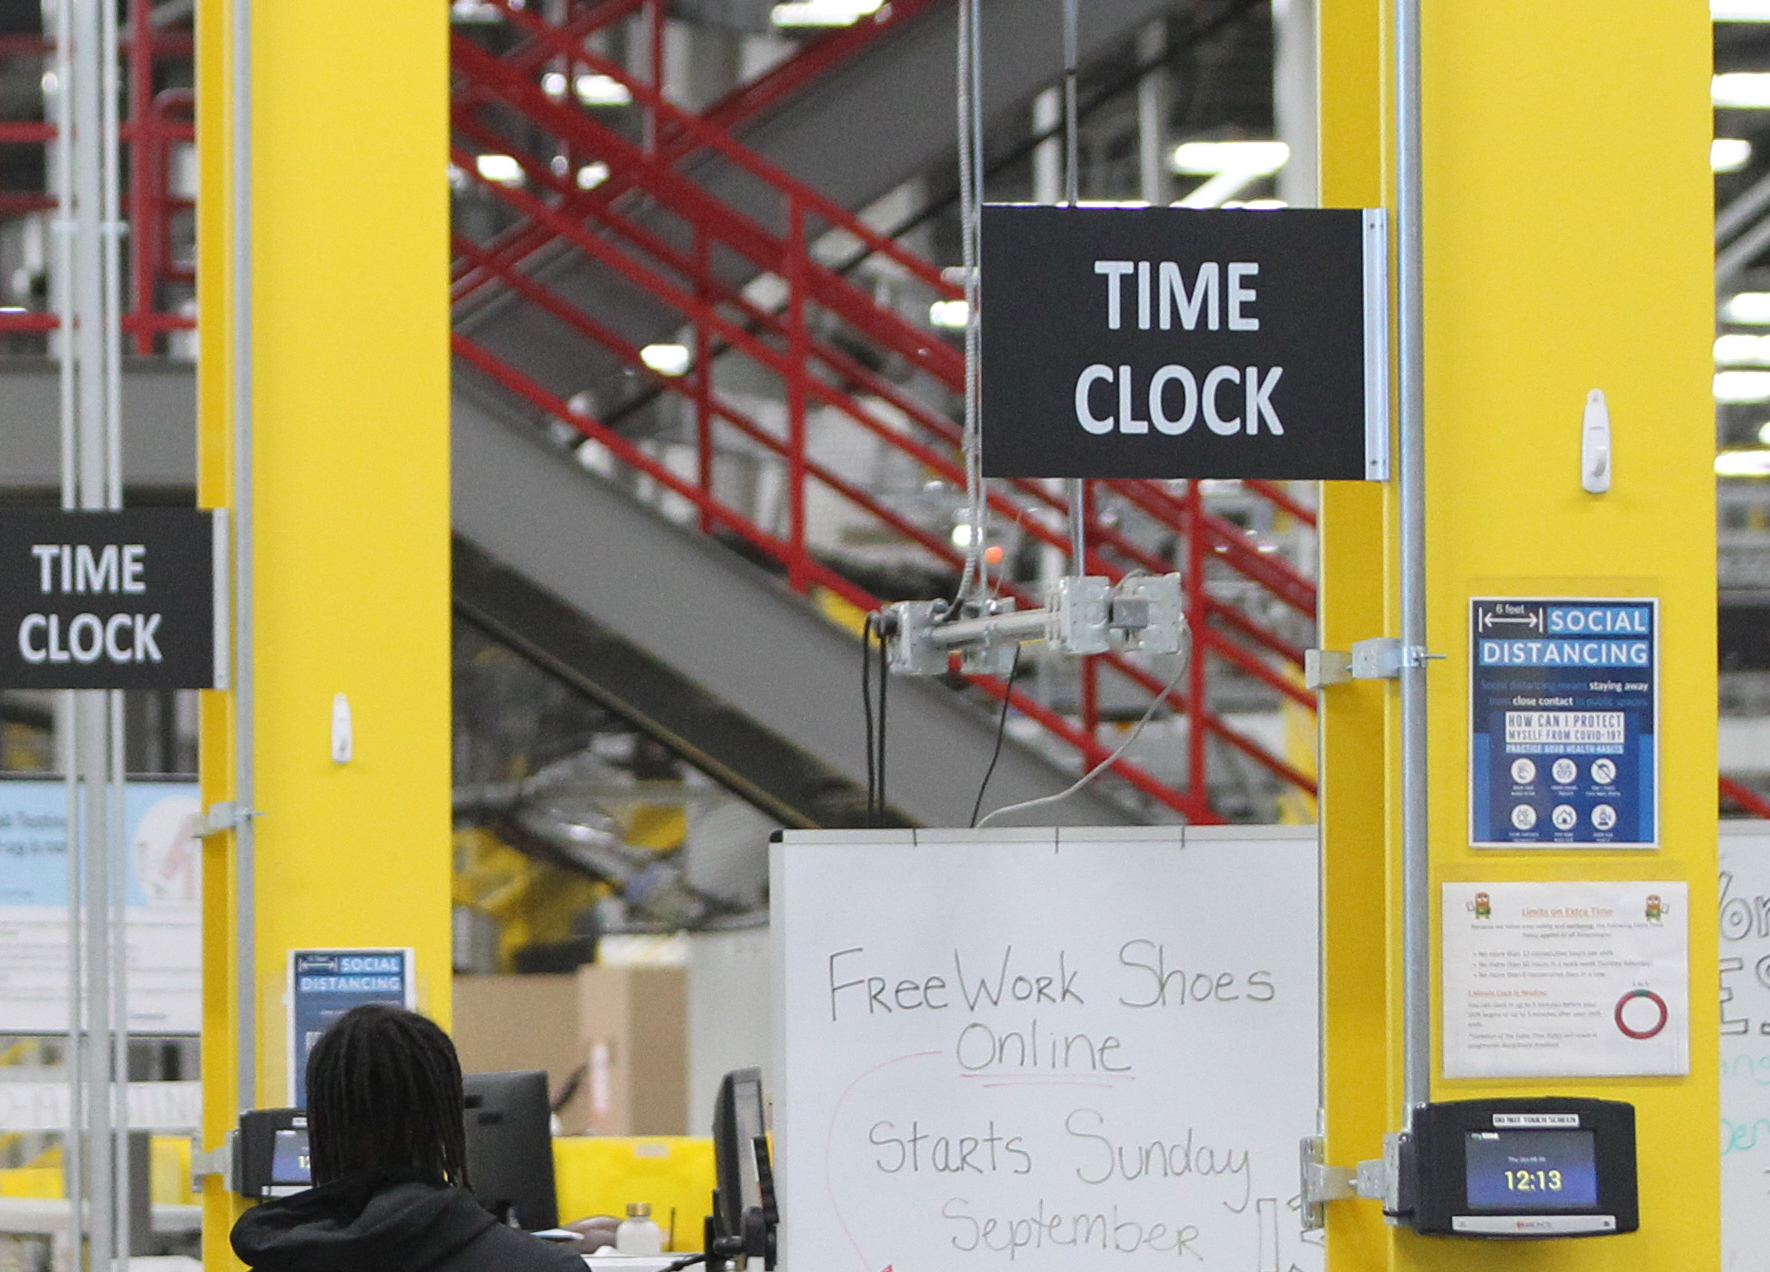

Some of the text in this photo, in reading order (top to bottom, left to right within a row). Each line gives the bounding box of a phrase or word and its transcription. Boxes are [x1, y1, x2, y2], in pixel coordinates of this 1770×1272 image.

[1094, 260, 1260, 332] TIME
[1074, 364, 1285, 436] CLOCK
[32, 543, 147, 595] TIME
[1496, 604, 1524, 613] 6 feet
[1551, 611, 1647, 631] SOCIAL
[18, 611, 162, 664] CLOCK
[1483, 642, 1648, 663] DISTANCING
[1589, 681, 1622, 692] staying
[1625, 682, 1648, 691] away
[1513, 697, 1536, 705] close
[1539, 697, 1574, 705] contact
[1508, 714, 1621, 728] HOW CAN I PROTECT
[1510, 729, 1621, 740] MYSELF FROM COVID-19?
[1506, 744, 1542, 753] PRACTICE
[1545, 744, 1564, 753] GOOD
[1566, 744, 1594, 753] HEALTH
[1521, 908, 1548, 917] Limits
[1565, 908, 1588, 917] Extra
[1591, 908, 1613, 917] Time
[341, 958, 399, 971] SOCIAL
[1118, 938, 1276, 1008] Shoes
[300, 976, 401, 990] DISTANCING
[956, 1018, 1133, 1072] Online
[1064, 1108, 1251, 1213] Sunday
[1505, 1170, 1562, 1191] 12:13
